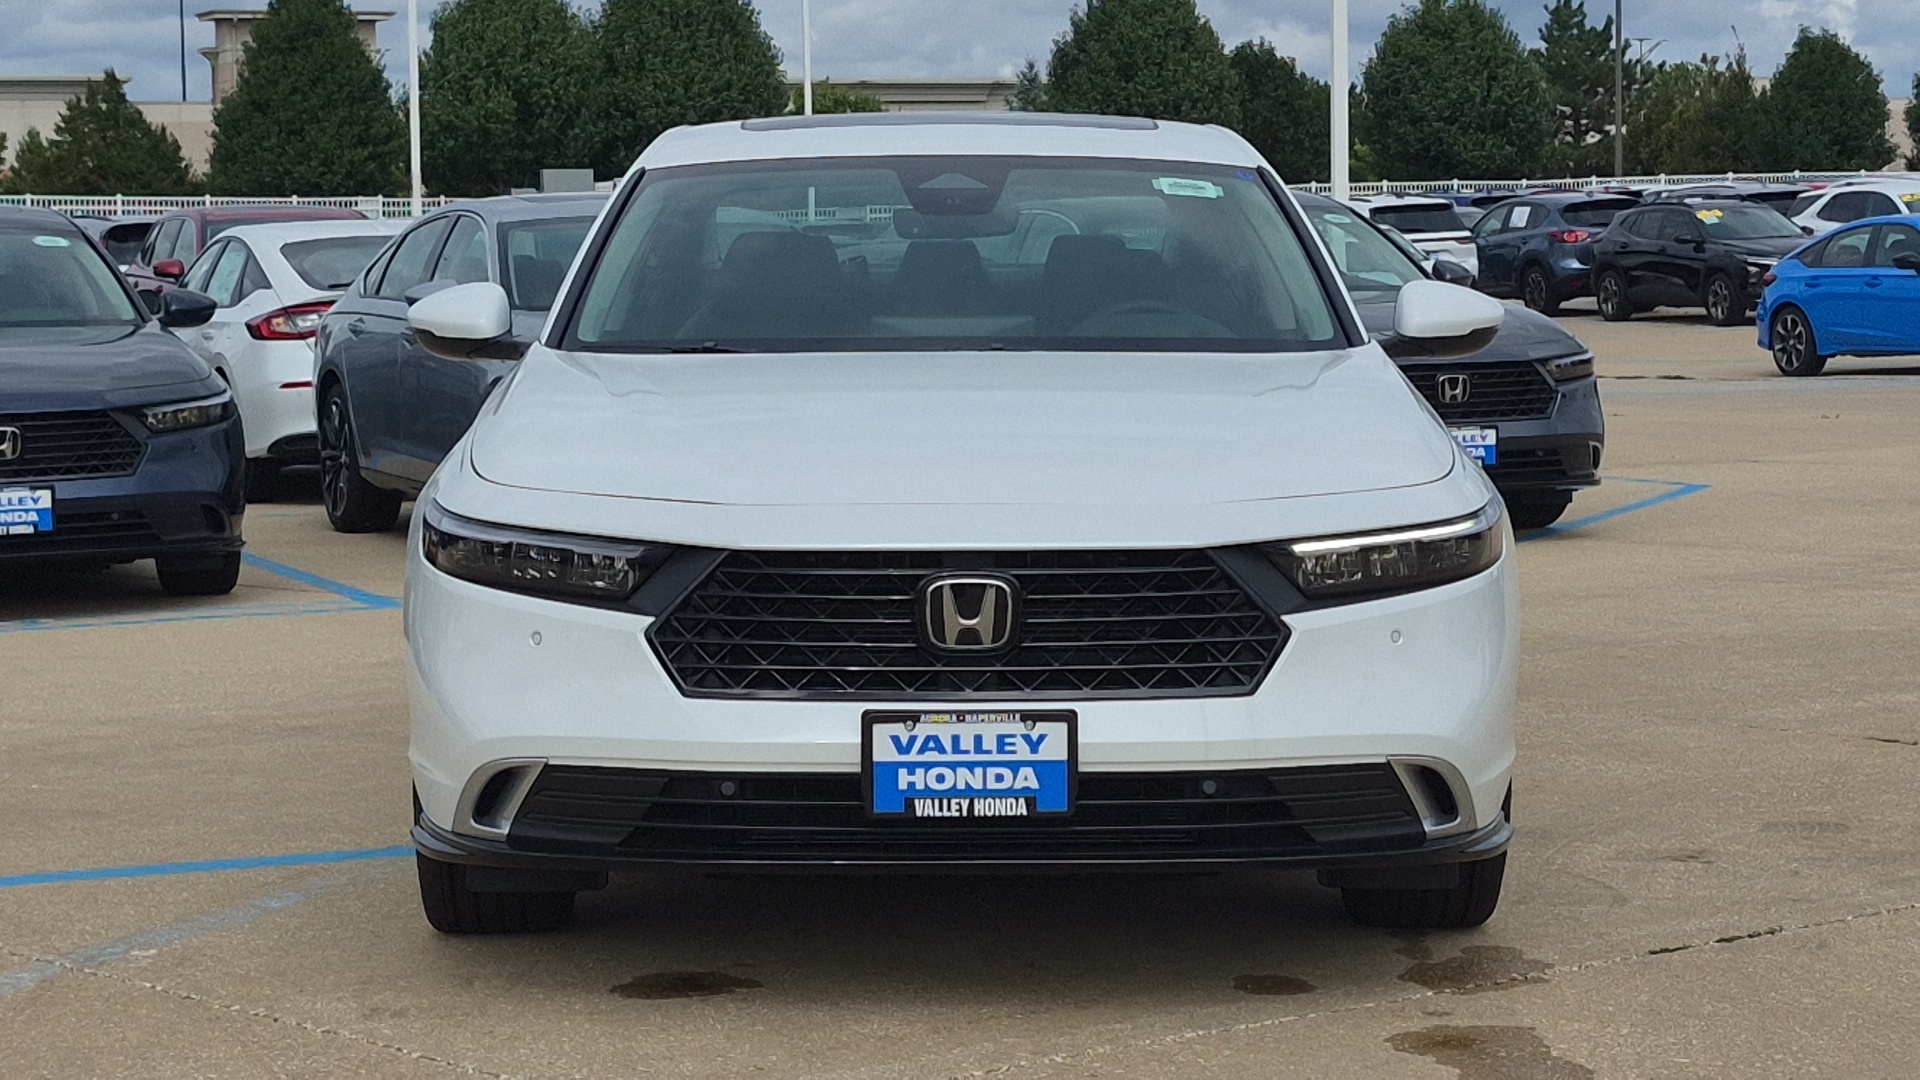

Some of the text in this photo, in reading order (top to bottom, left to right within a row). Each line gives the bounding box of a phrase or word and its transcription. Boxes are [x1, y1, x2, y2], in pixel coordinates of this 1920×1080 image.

[0, 496, 42, 507] LLEY
[0, 511, 39, 523] NDA
[889, 733, 1049, 756] VALLEY
[897, 766, 1041, 791] HONDA
[914, 797, 1028, 818] VALLEY HONDA
